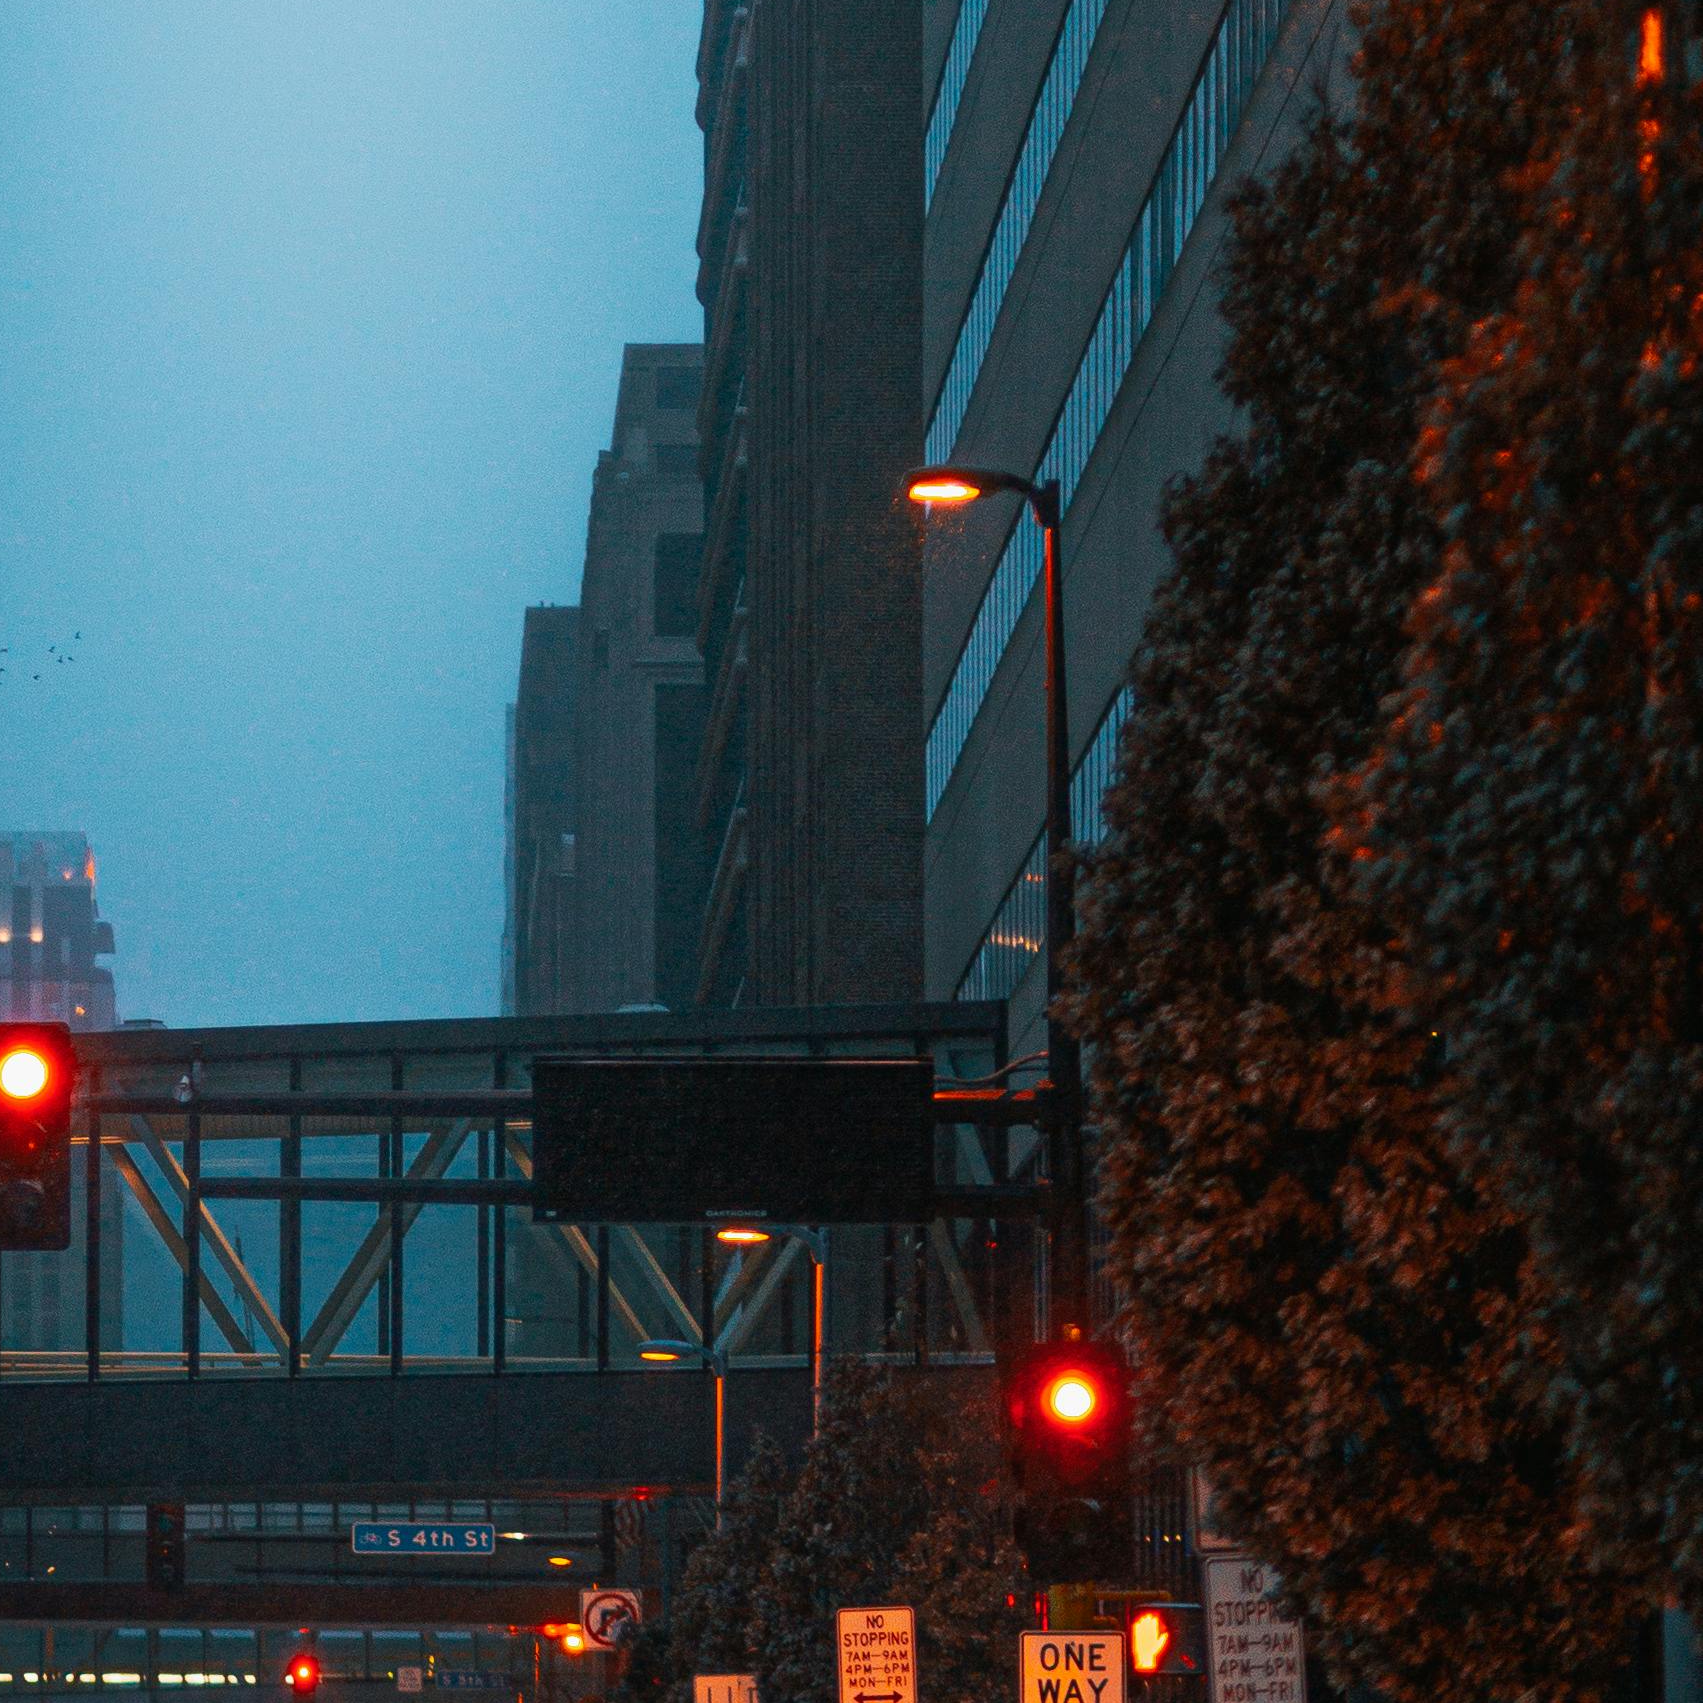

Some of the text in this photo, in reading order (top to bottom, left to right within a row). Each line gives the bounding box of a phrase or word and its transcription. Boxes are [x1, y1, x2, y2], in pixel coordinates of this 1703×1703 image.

[387, 1528, 489, 1547] S 4th St
[1240, 1567, 1265, 1593] NO
[865, 1614, 885, 1629] NO
[843, 1631, 909, 1647] STOPPING
[1039, 1642, 1107, 1672] ONE
